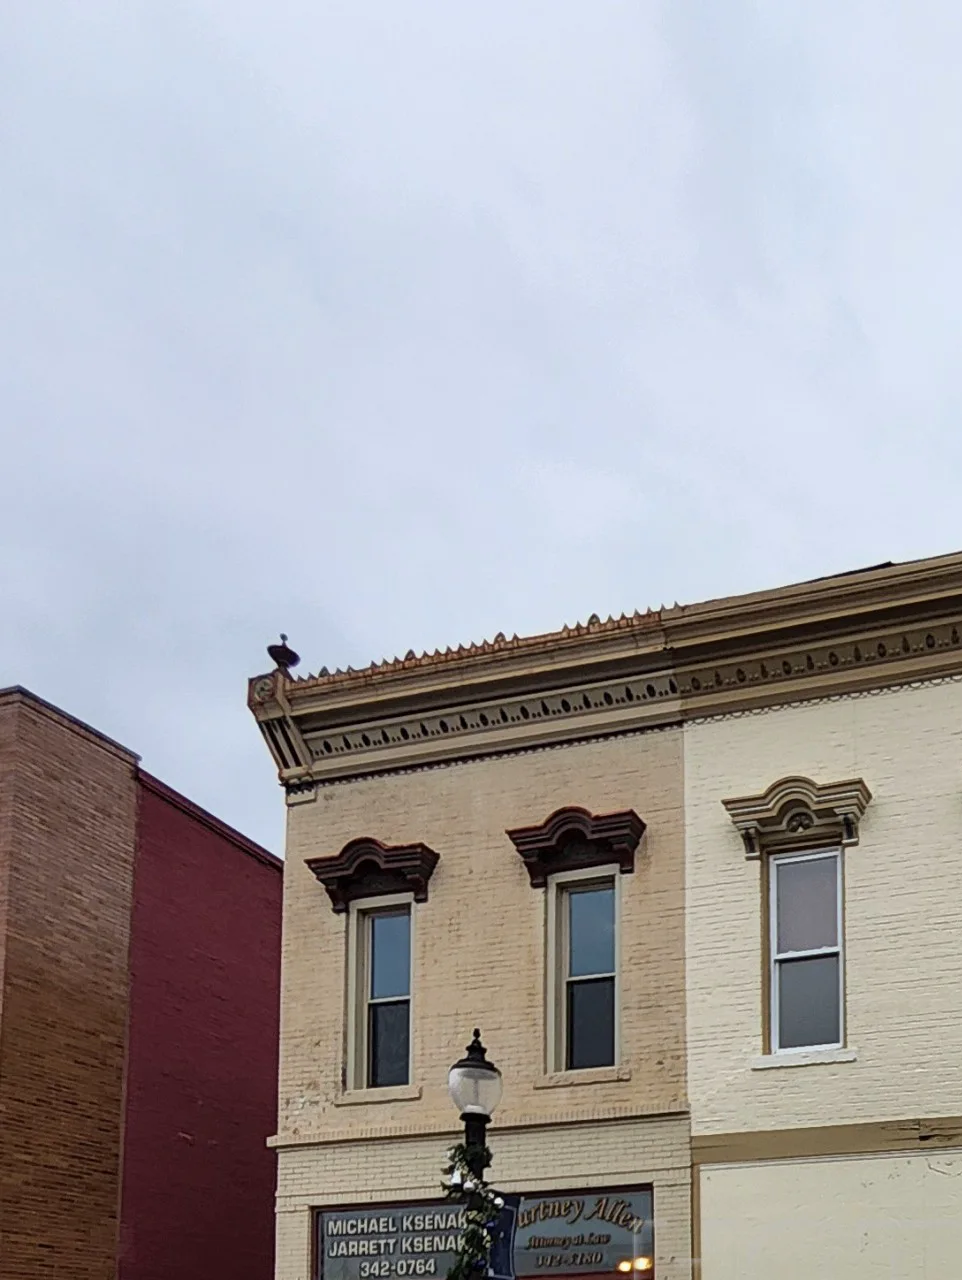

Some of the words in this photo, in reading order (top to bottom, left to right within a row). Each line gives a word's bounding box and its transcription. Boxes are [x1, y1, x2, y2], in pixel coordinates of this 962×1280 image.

[584, 1197, 644, 1234] Allen
[327, 1216, 397, 1236] MICHAEL
[328, 1238, 397, 1257] JARRETT
[585, 1232, 611, 1245] Law
[360, 1257, 436, 1278] 342-0764
